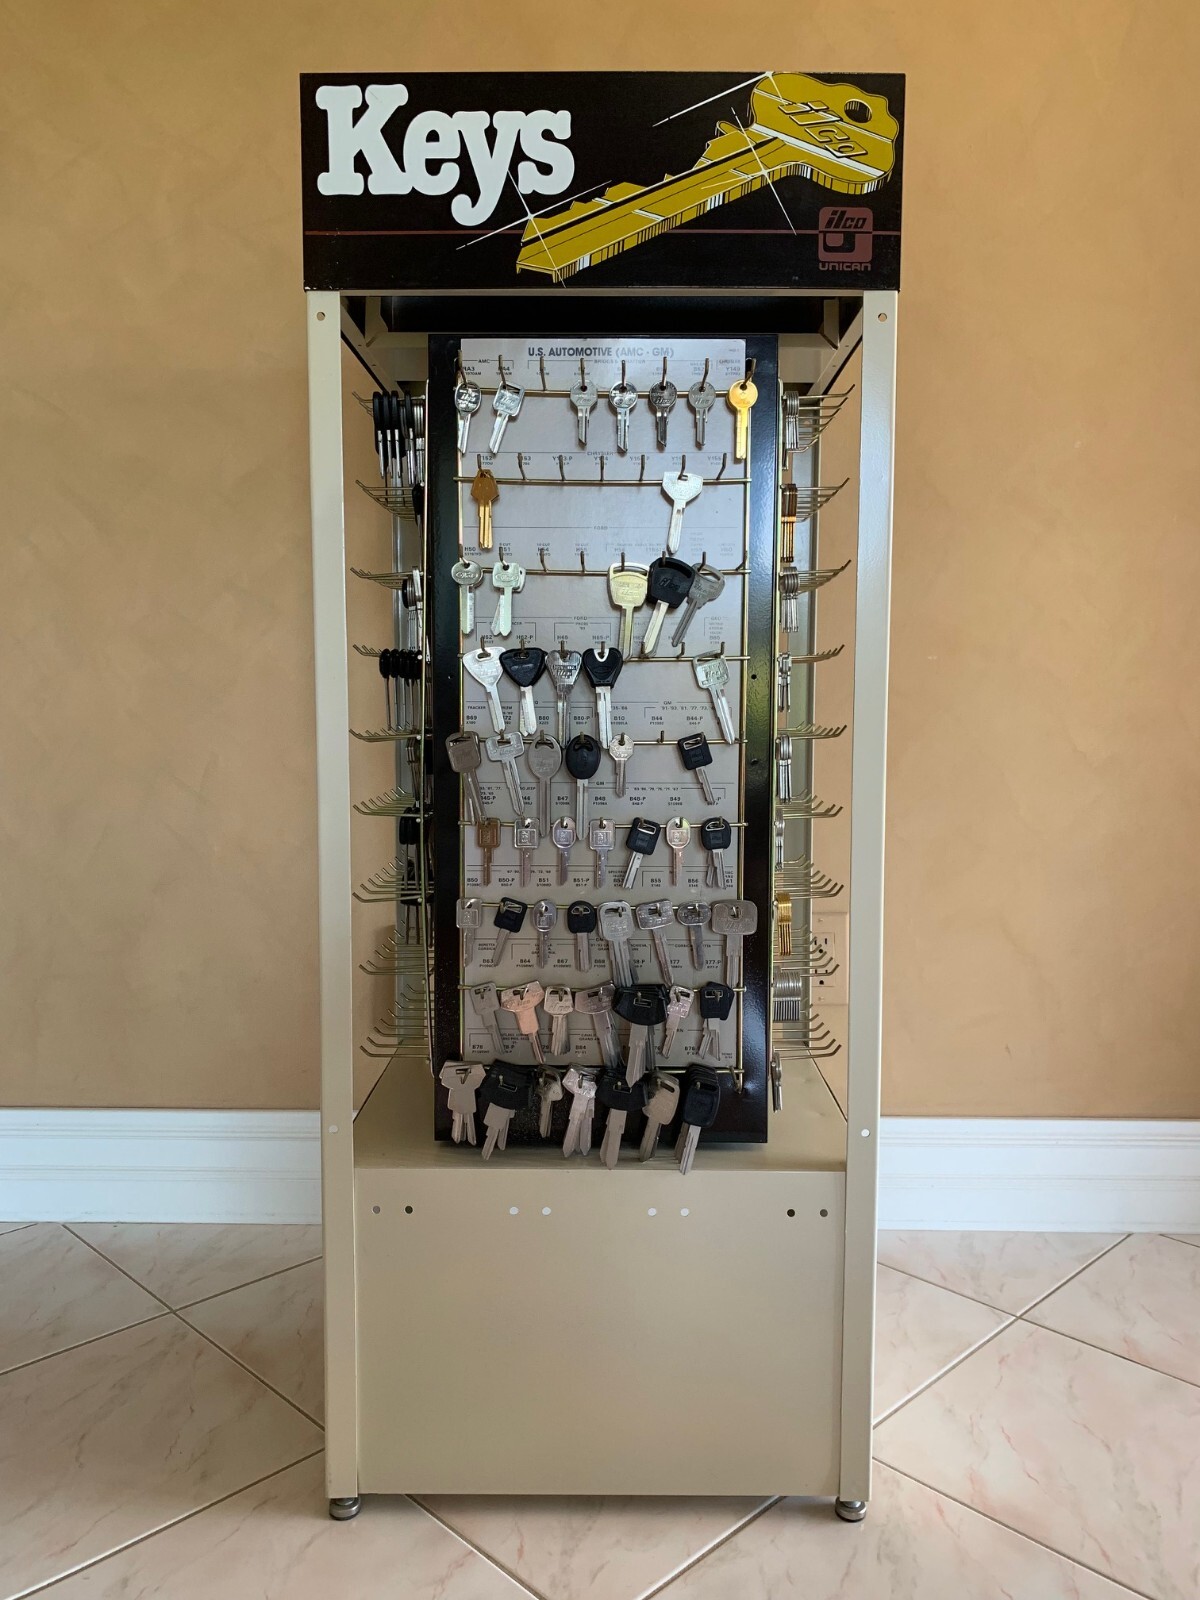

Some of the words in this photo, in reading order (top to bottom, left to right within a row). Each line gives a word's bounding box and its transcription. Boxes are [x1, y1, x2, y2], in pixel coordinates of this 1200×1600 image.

[315, 83, 574, 226] Keys
[824, 209, 868, 229] ilco
[818, 262, 872, 271] UNICAN
[527, 346, 546, 357] U.S.
[548, 346, 613, 357] AUTOMOTIVE
[615, 346, 644, 359] (AMC
[652, 346, 675, 359] GM)
